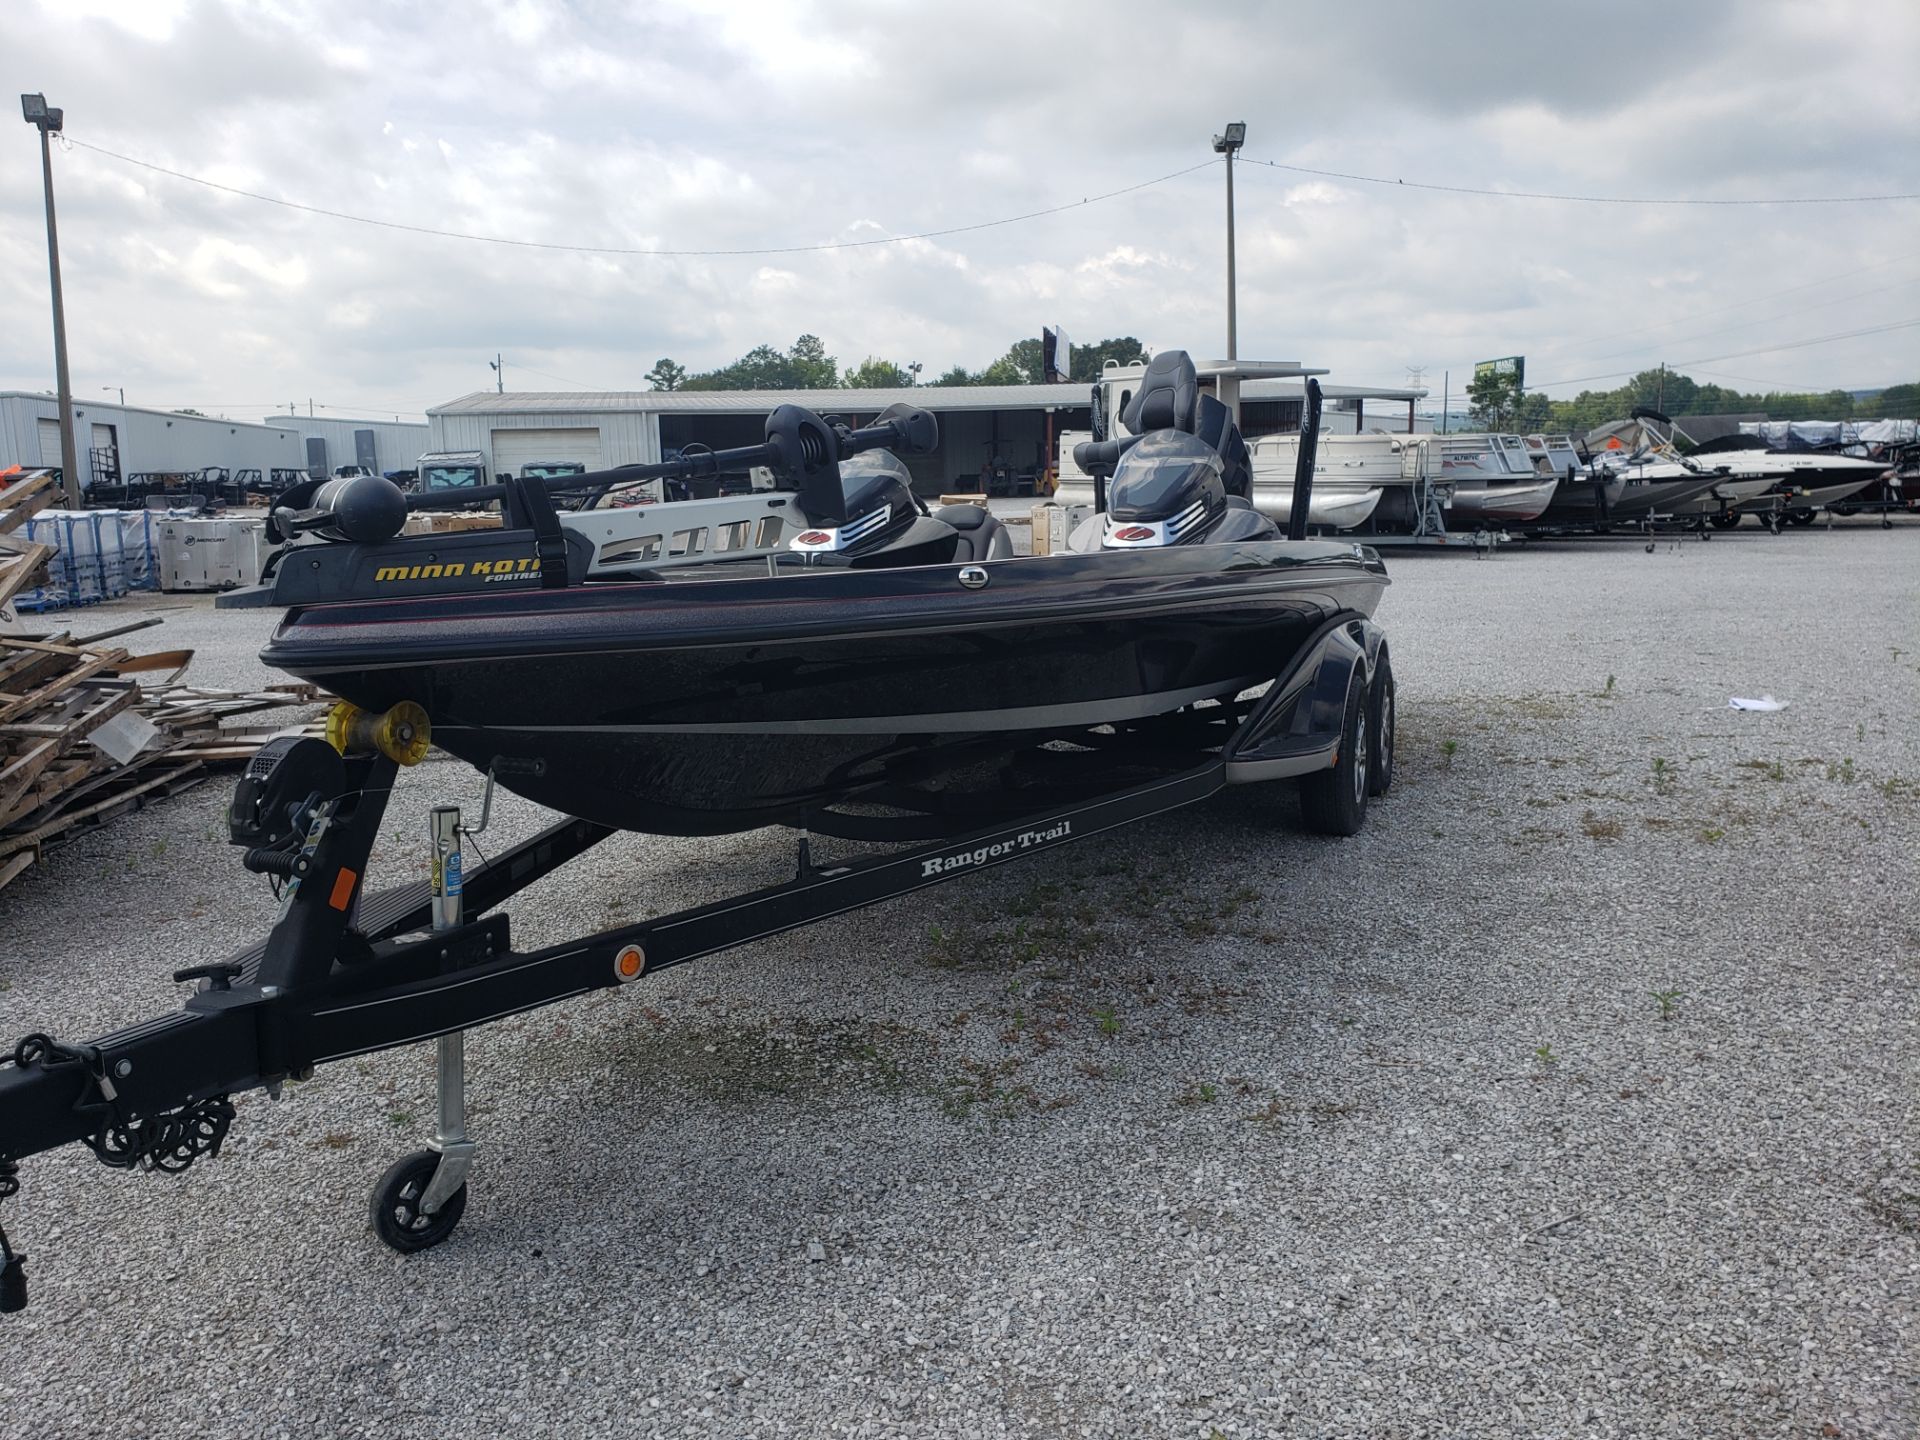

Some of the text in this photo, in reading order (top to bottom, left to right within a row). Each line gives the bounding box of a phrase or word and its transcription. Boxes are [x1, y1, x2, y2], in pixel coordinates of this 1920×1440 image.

[375, 563, 465, 582] MINN
[921, 821, 1072, 878] Ranger Trail
